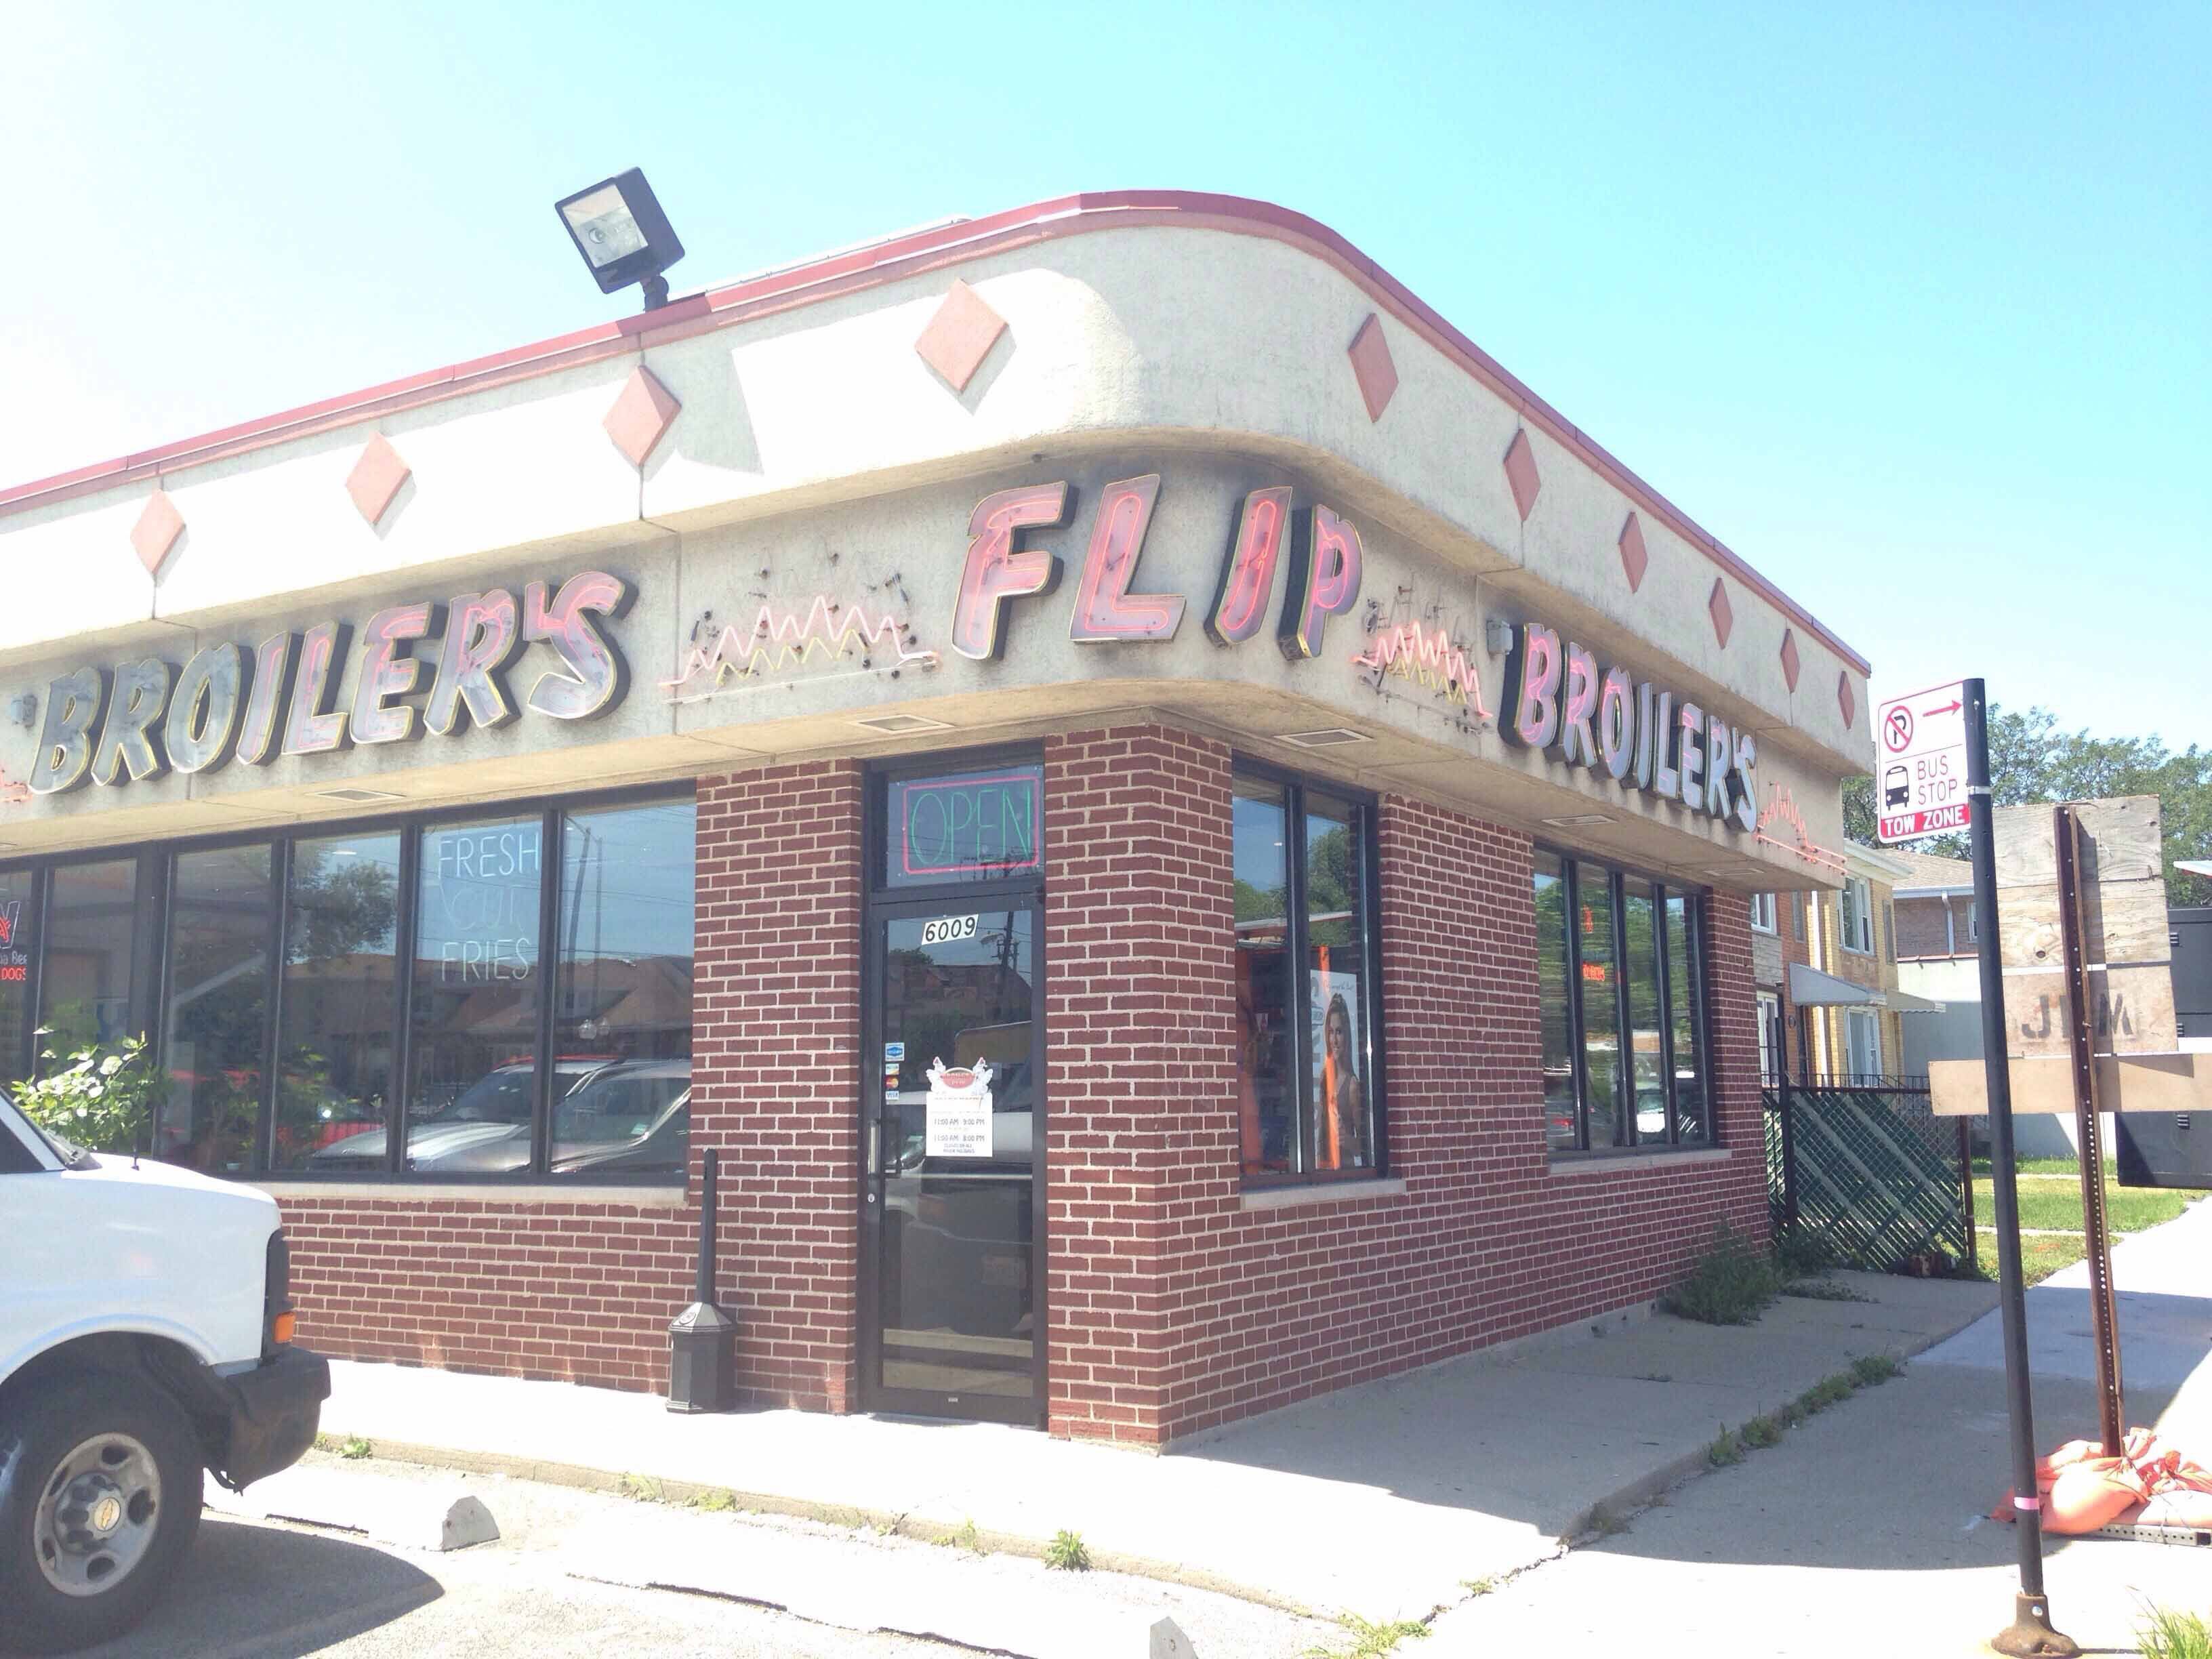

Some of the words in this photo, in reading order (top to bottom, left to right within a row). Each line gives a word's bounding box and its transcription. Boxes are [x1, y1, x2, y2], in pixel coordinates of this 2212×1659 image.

[951, 473, 1363, 661] FLIP
[27, 570, 632, 795] BROILER'S
[1506, 622, 1758, 834] BROILER'S
[1917, 755, 1950, 781] BUS
[1917, 779, 1958, 805] STOP
[911, 786, 1031, 865] OPEN
[1885, 813, 1916, 836] TOW
[1923, 805, 1965, 830] ZONE
[438, 832, 539, 880] FRESH
[925, 916, 976, 942] 6009
[441, 937, 530, 983] FRIES
